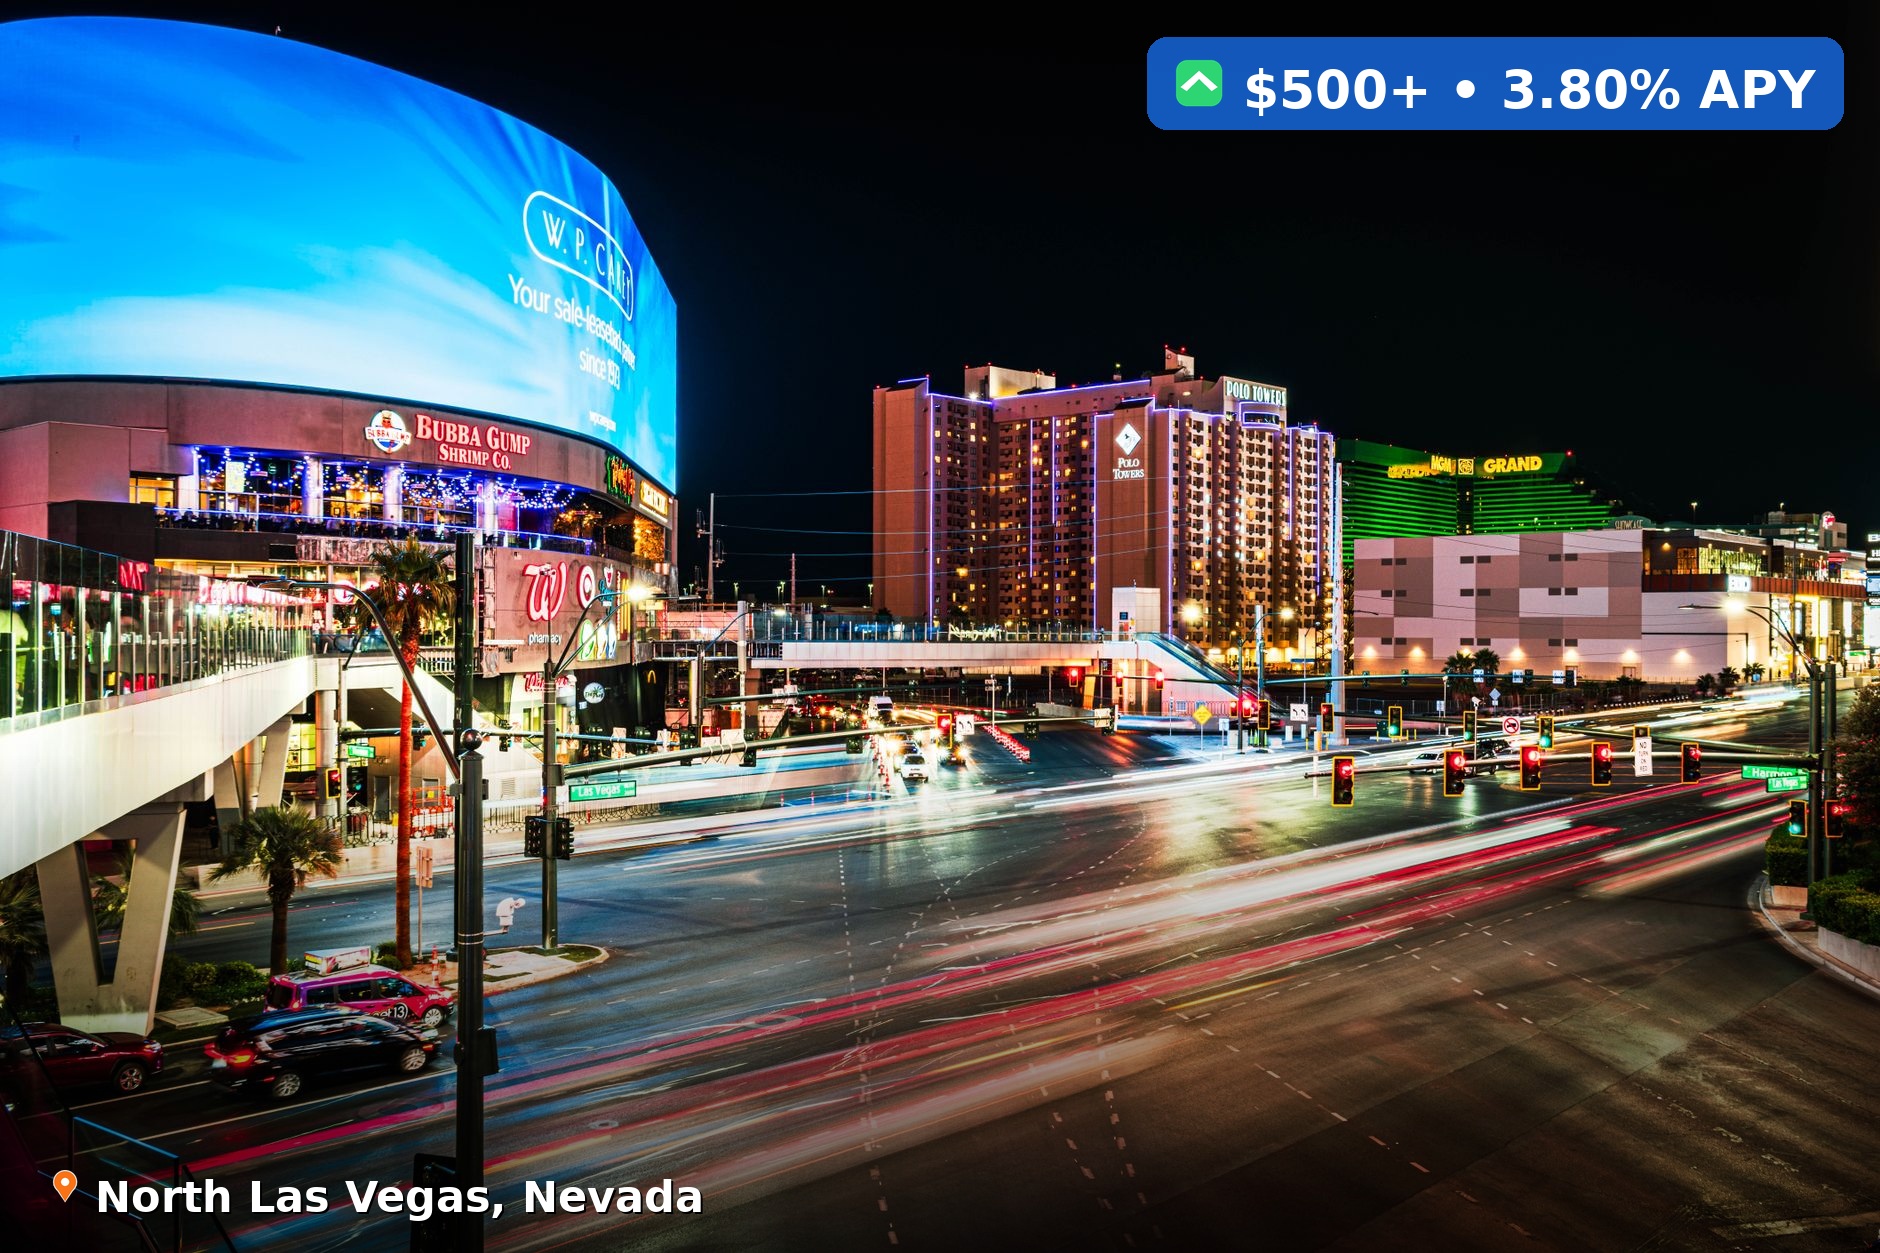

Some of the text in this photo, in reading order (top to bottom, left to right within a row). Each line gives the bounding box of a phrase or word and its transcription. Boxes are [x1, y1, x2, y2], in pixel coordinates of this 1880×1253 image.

[508, 273, 551, 314] Your
[580, 347, 607, 380] since
[1226, 380, 1287, 407] POLO TOWERS
[415, 413, 532, 456] BUBBA GUMP
[439, 443, 512, 471] SHRIMP CO.
[1118, 457, 1140, 468] POLO
[1430, 455, 1452, 473] MGM
[1483, 455, 1543, 474] GRAND
[1112, 468, 1145, 480] TOWERS
[527, 631, 562, 646] pharmacy
[1639, 741, 1648, 749] NO
[1751, 767, 1794, 779] Harmon
[578, 785, 594, 797] Las
[595, 782, 621, 798] Vegas
